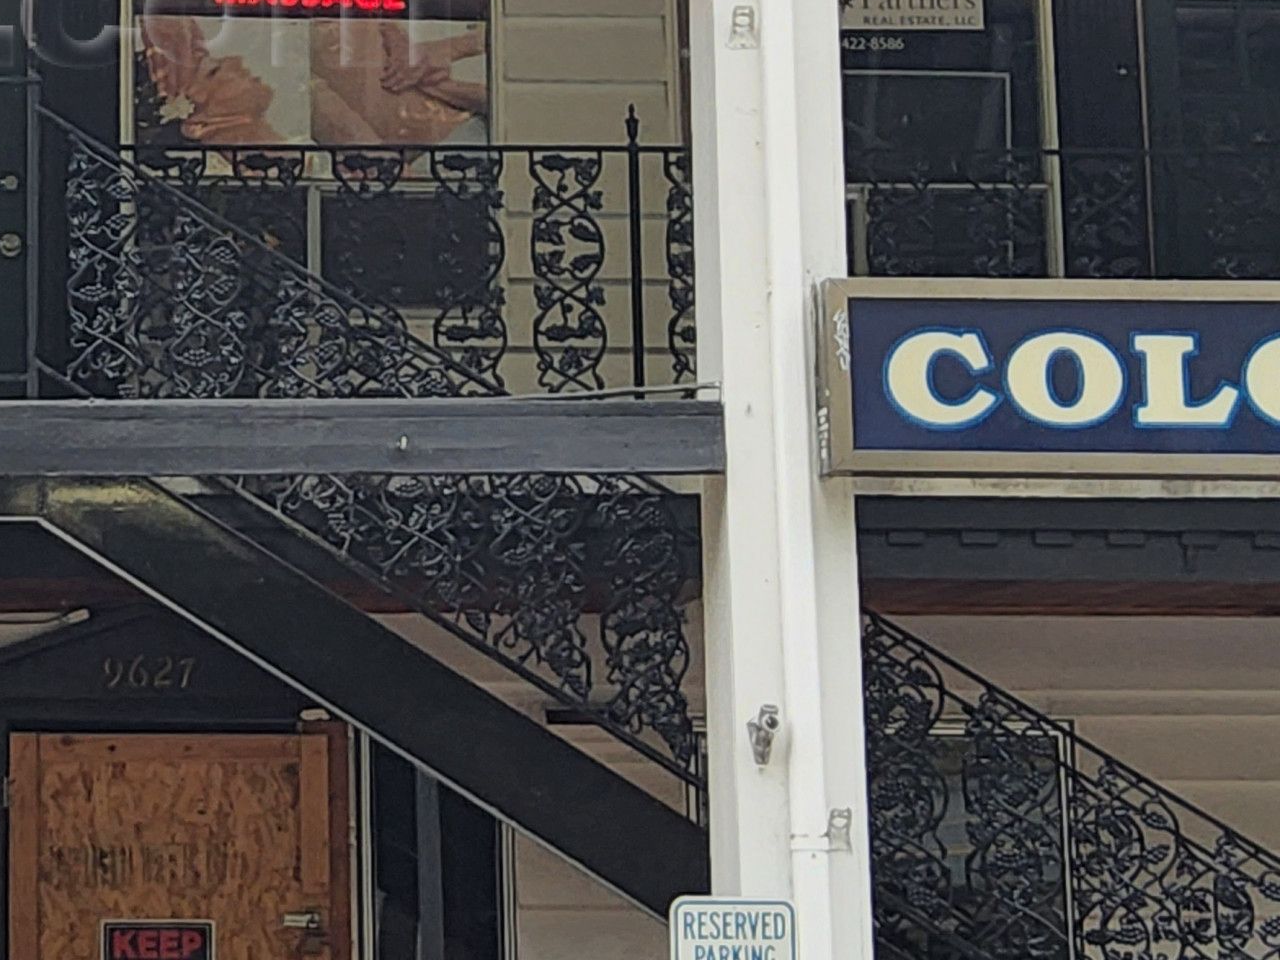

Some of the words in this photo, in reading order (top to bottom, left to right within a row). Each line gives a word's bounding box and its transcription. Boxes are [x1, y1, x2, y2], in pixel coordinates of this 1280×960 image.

[863, 15, 894, 26] REAL
[955, 15, 977, 26] LLC
[882, 325, 1280, 431] COL
[103, 653, 196, 689] 9627
[683, 911, 786, 941] RESERVED
[112, 930, 203, 959] KEEP
